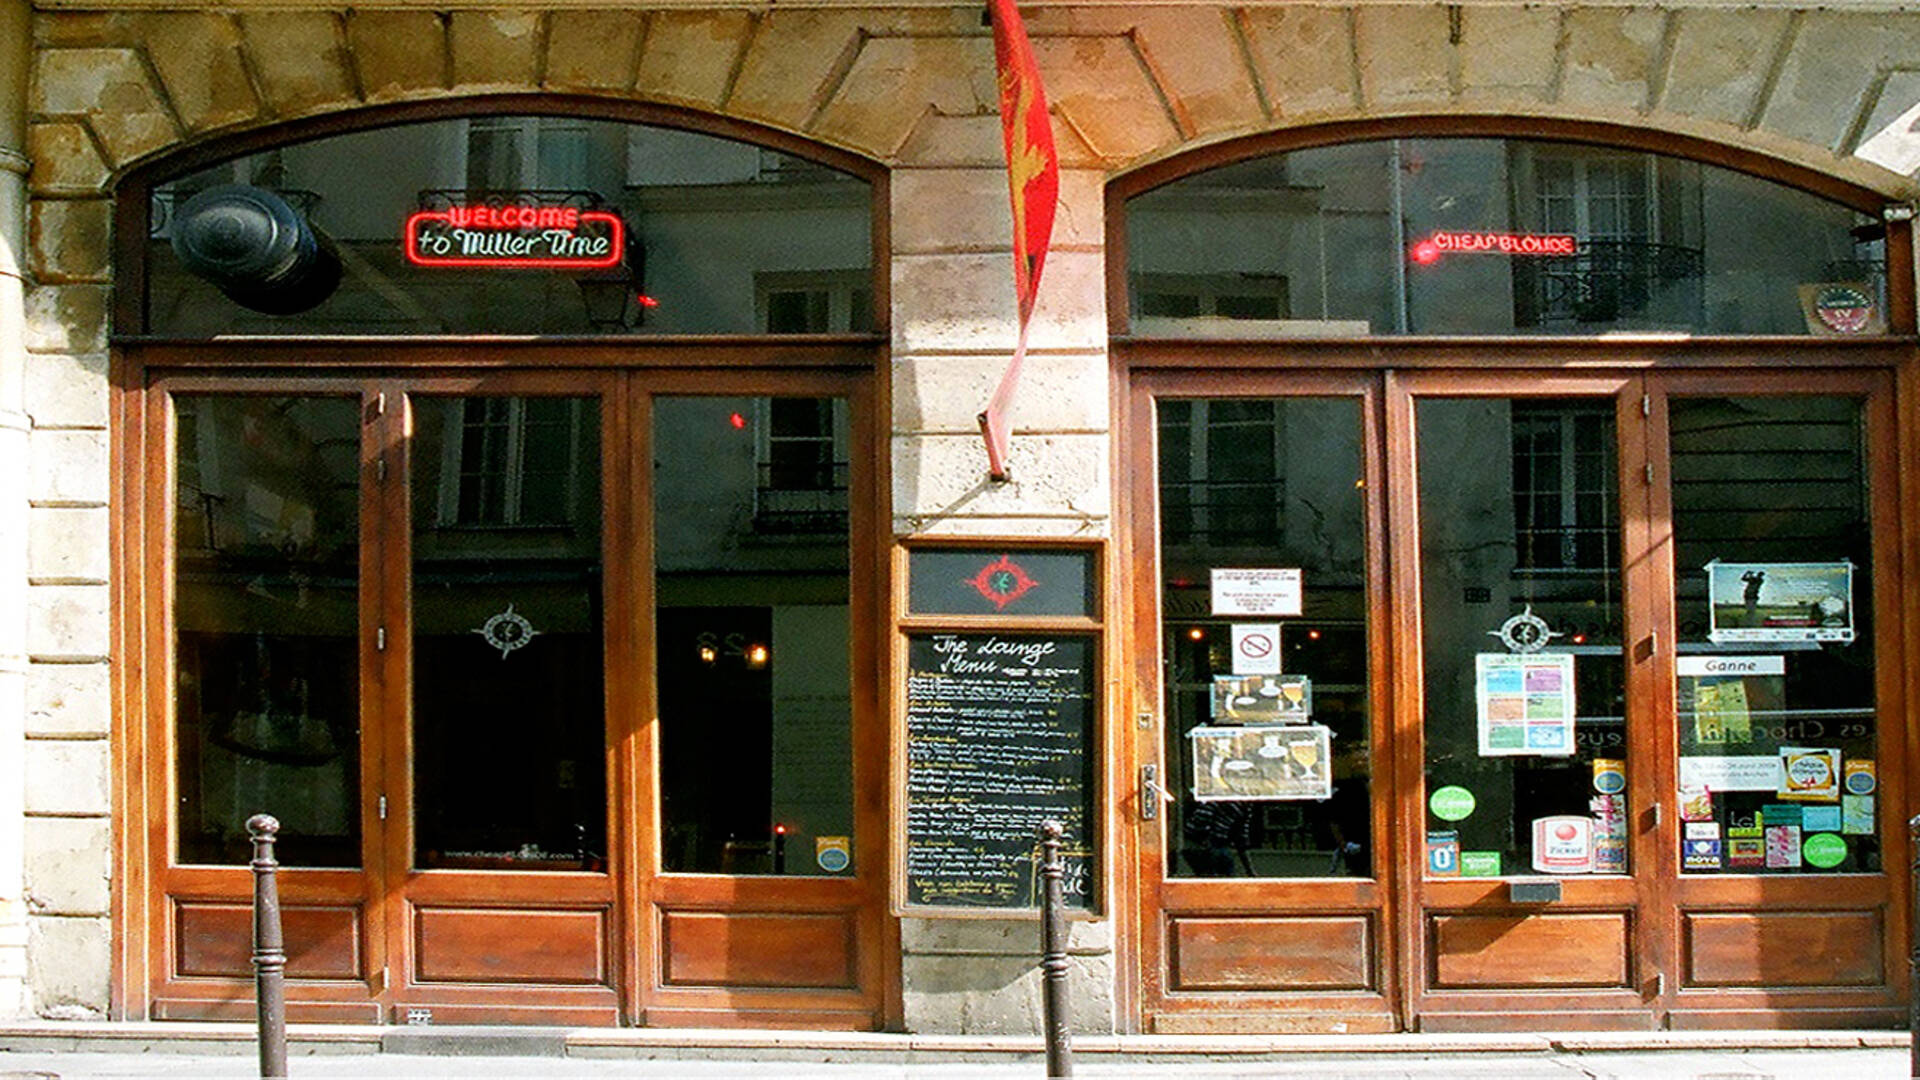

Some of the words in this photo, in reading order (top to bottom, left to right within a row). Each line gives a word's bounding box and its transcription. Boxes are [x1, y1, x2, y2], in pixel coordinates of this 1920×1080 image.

[450, 207, 578, 228] WELCOME
[418, 230, 451, 255] to
[453, 229, 543, 255] Miller
[542, 229, 609, 255] Time
[933, 635, 968, 654] The
[977, 636, 1056, 666] Lounge
[940, 654, 999, 673] Menu
[1705, 660, 1757, 671] Ganne
